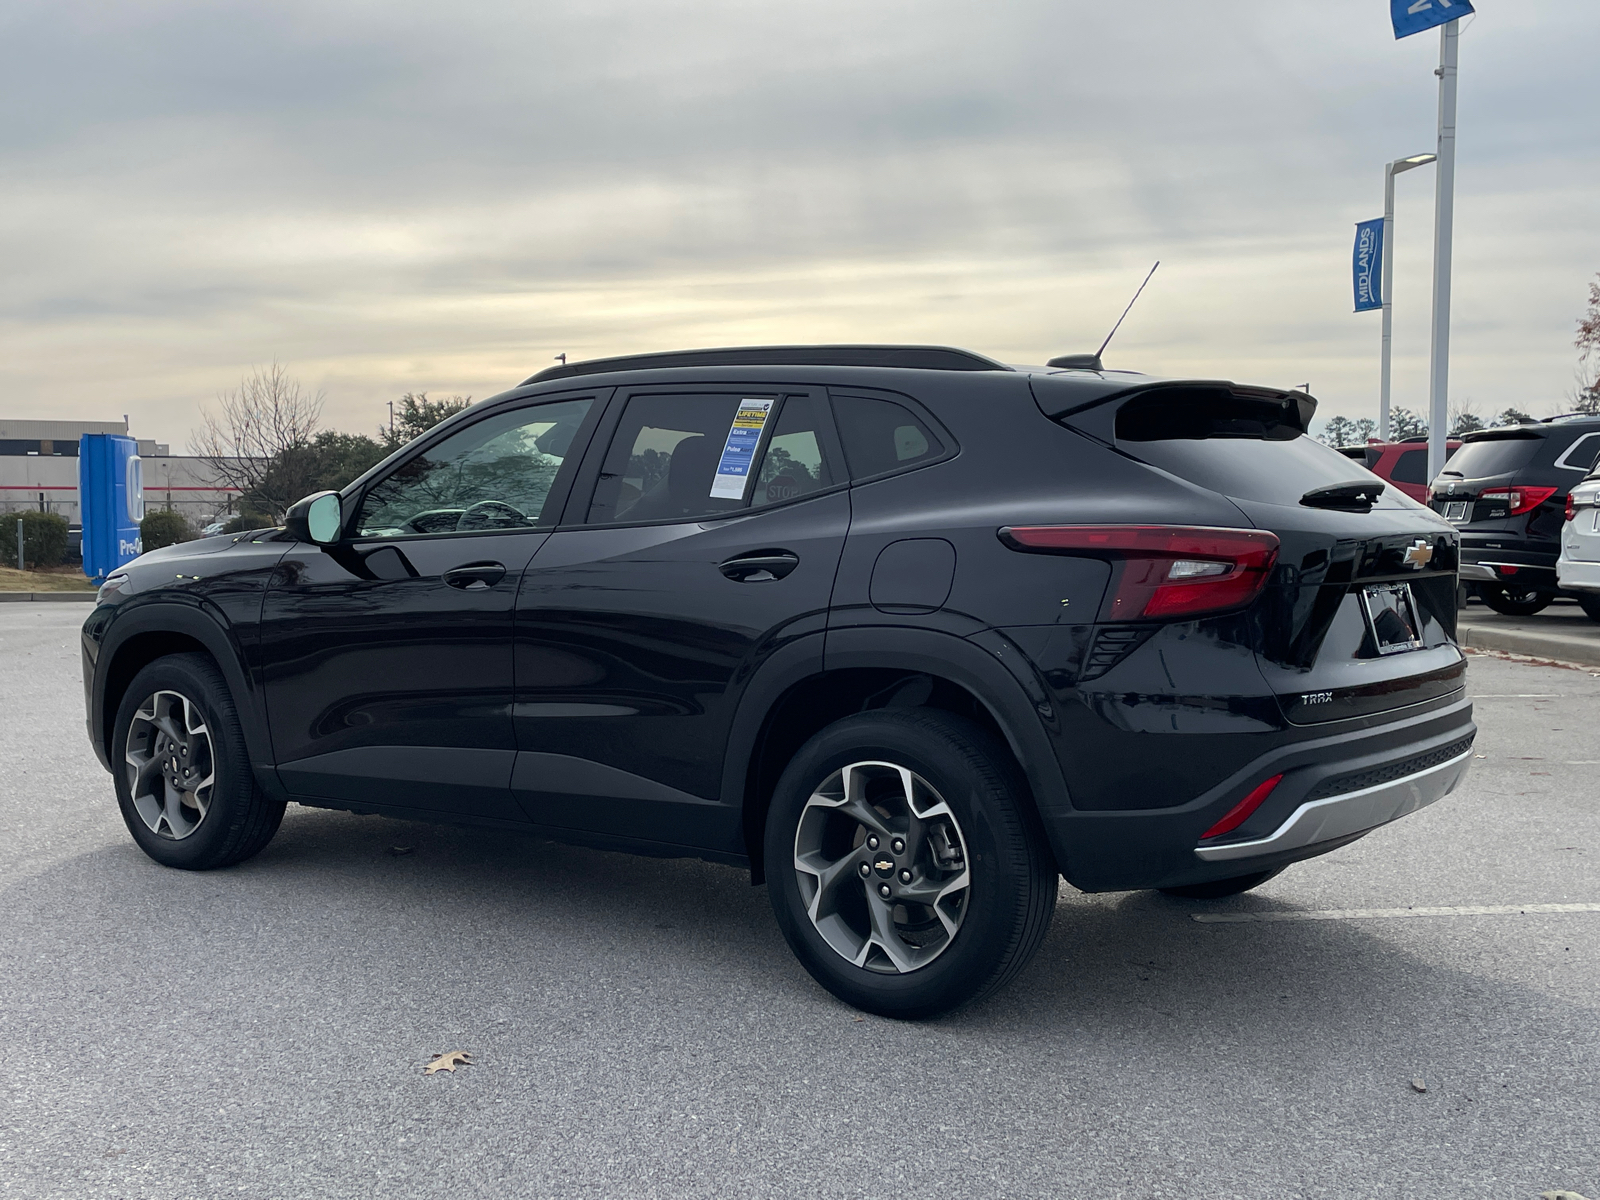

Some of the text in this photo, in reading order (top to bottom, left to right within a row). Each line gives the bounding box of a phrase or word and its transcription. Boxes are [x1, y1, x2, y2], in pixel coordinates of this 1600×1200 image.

[1359, 227, 1371, 303] MIDLANDS
[768, 485, 799, 499] STOP
[1301, 691, 1333, 705] TRAX
